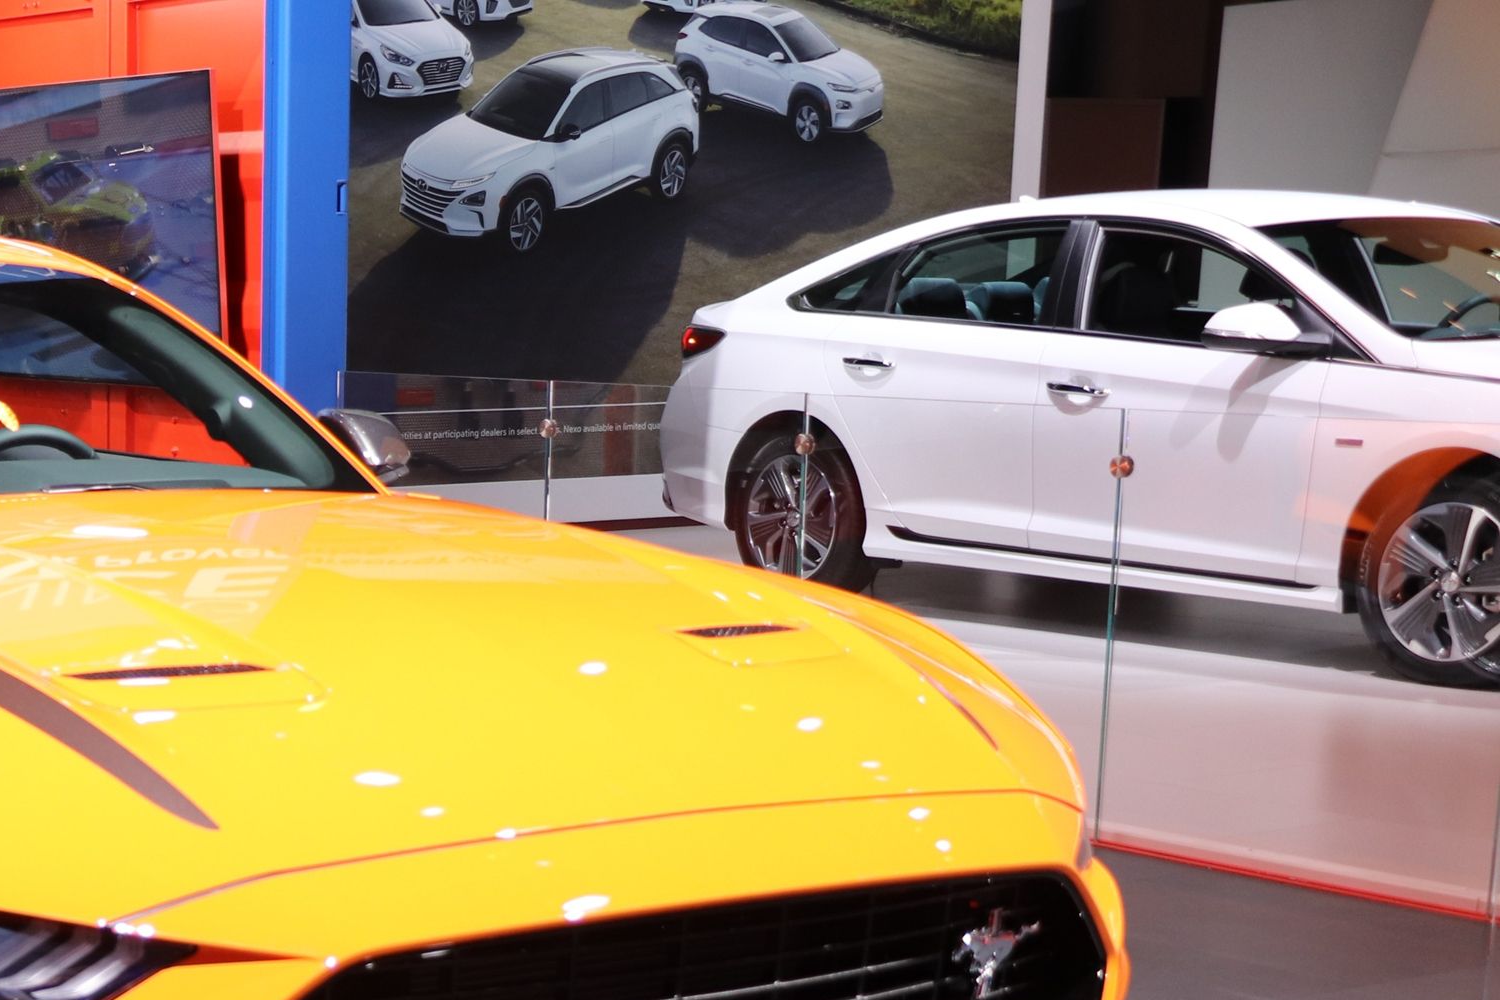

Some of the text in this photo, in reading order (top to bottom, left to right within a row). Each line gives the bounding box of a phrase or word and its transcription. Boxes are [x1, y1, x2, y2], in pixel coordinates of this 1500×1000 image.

[423, 431, 431, 440] at
[433, 428, 479, 441] participating
[480, 427, 507, 438] dealers
[508, 427, 516, 436] in
[516, 426, 538, 436] select
[563, 424, 582, 434] Nexo
[583, 423, 614, 433] available
[622, 421, 646, 431] limited
